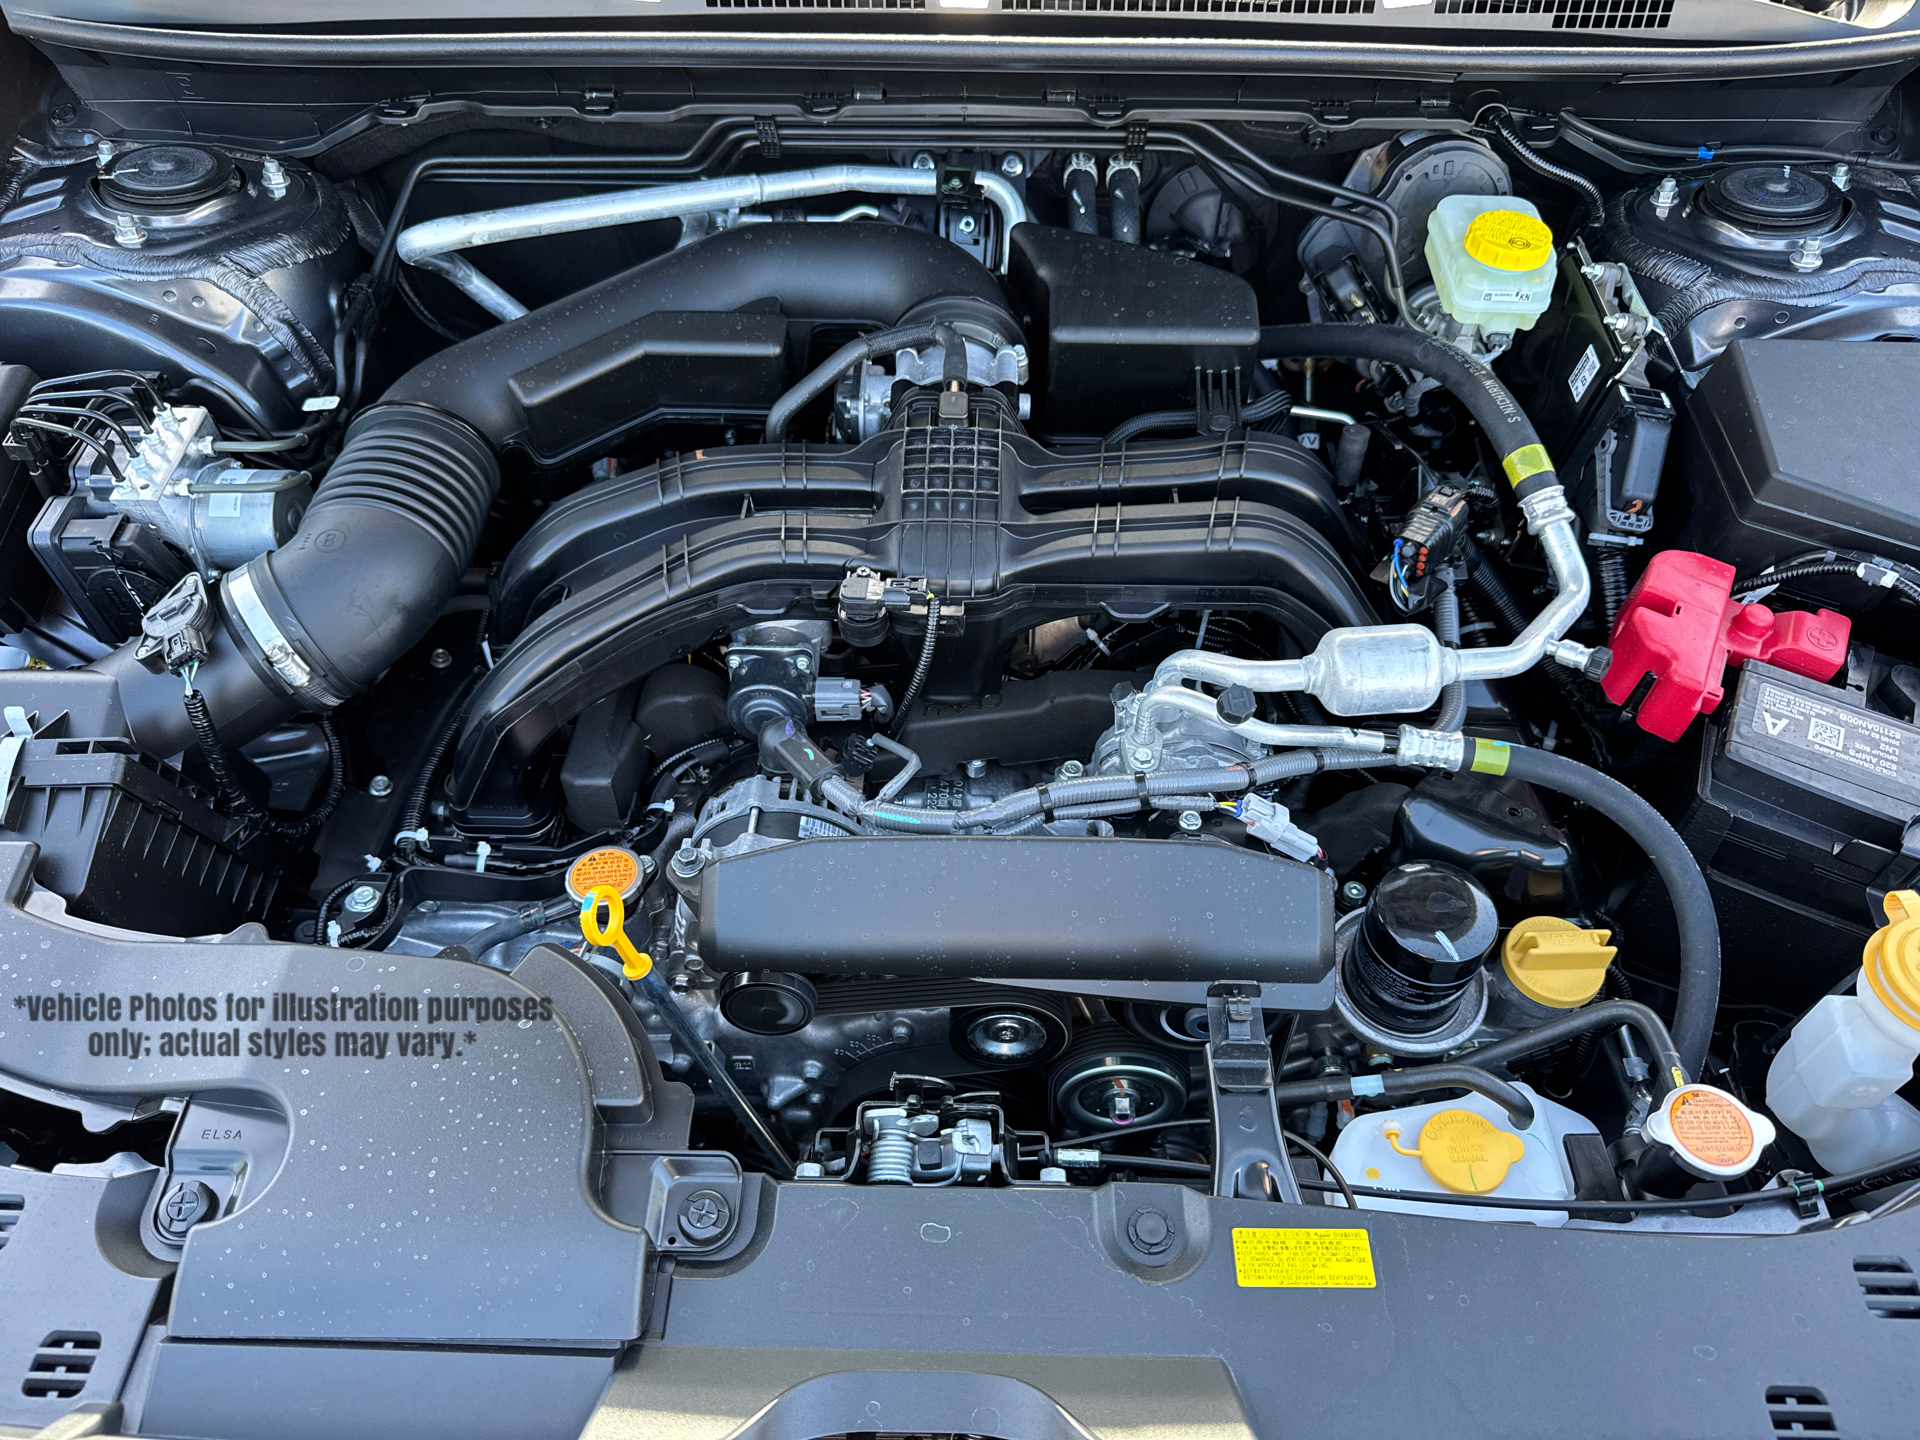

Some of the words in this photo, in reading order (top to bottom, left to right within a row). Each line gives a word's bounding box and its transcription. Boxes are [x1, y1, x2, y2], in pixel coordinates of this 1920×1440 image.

[1814, 744, 1834, 757] AMPS
[1854, 742, 1874, 751] SIZE
[1879, 744, 1899, 756] LN2
[1836, 752, 1874, 770] CRANKING
[1849, 749, 1879, 764] AMPS
[1874, 748, 1899, 762] GROUP
[1876, 765, 1897, 778] COLD
[1380, 964, 1409, 986] CAUTION
[1425, 1113, 1496, 1140] COOLANT
[201, 1129, 242, 1140] ELSA
[1450, 1134, 1470, 1142] SEE
[1449, 1154, 1488, 1163] MANUAL
